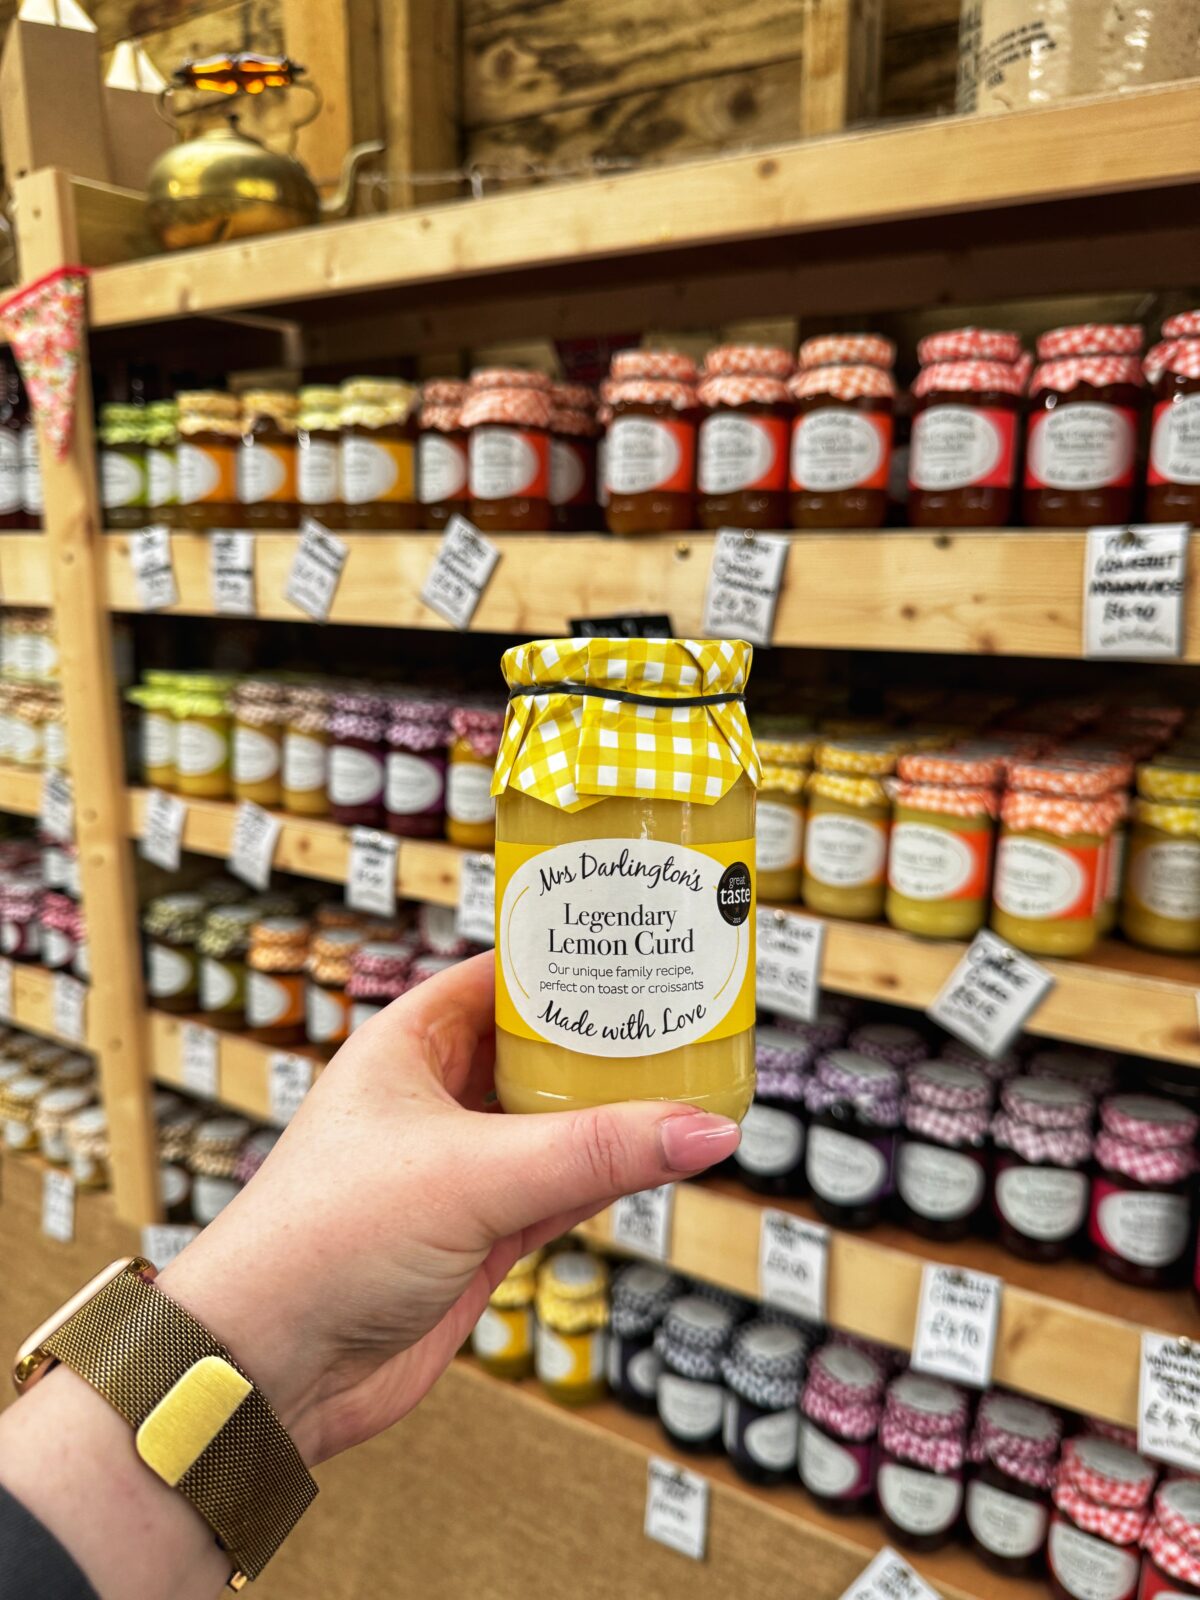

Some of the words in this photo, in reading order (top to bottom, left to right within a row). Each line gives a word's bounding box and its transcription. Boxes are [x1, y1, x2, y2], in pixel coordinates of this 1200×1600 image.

[539, 865, 577, 896] Mrs
[579, 848, 703, 892] Darlington's
[729, 876, 746, 889] great
[720, 887, 751, 905] taste
[563, 902, 678, 933] Legendary
[547, 928, 629, 956] Lemon
[634, 928, 695, 956] Curd
[548, 962, 569, 976] Our
[572, 965, 613, 980] unique
[616, 964, 653, 981] family
[656, 964, 694, 979] recipe,
[540, 978, 577, 993] perfect
[580, 984, 595, 994] on
[598, 983, 629, 995] toast
[632, 984, 646, 994] or
[648, 980, 704, 994] croissants
[537, 999, 598, 1037] Made
[601, 1009, 656, 1041] with
[661, 1003, 707, 1035] Love
